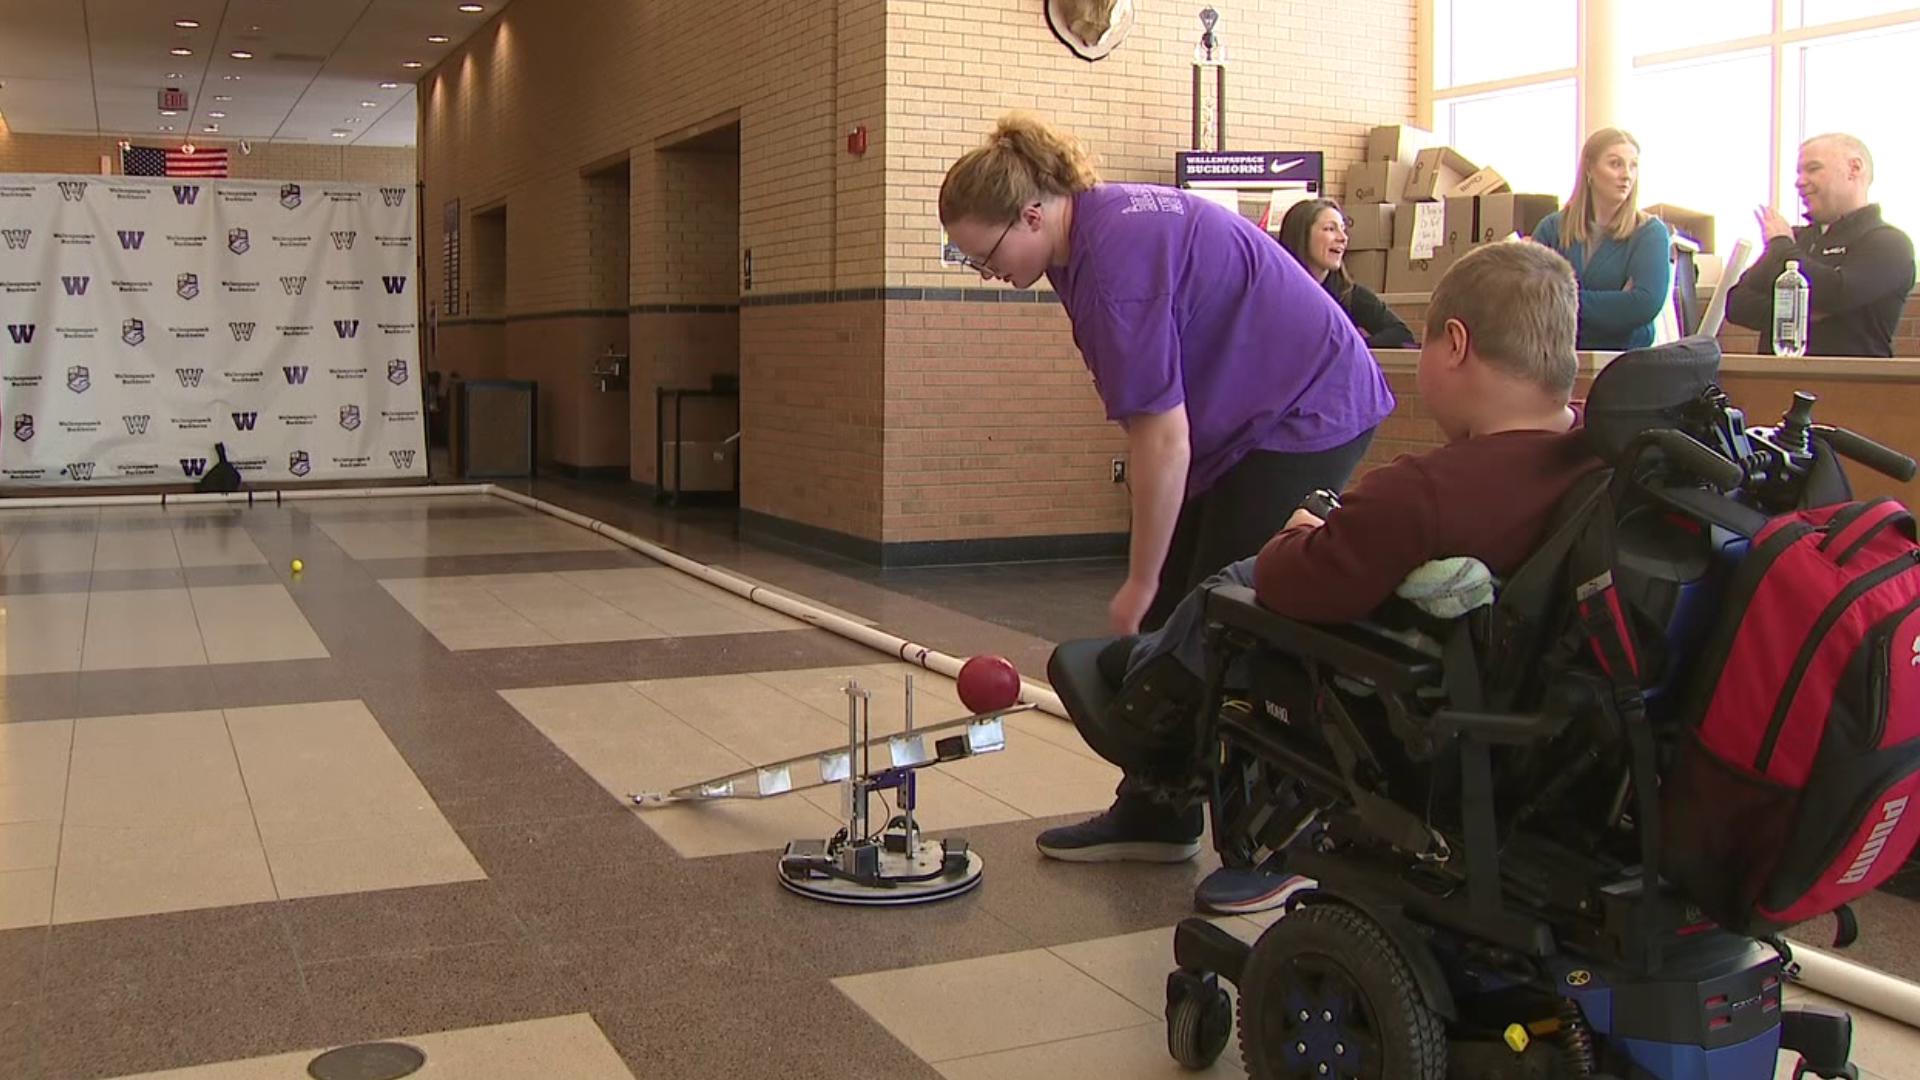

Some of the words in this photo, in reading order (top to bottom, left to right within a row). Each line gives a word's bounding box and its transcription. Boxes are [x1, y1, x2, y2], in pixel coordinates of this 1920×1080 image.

[1186, 165, 1265, 174] BUCKHORNS
[57, 181, 88, 201] W
[172, 185, 199, 205] W
[379, 188, 405, 207] W
[1, 229, 32, 249] W
[117, 231, 144, 249] W
[329, 231, 356, 250] W
[61, 276, 90, 295] W
[280, 276, 307, 295] W
[382, 276, 406, 294] W
[7, 324, 35, 343] W
[228, 322, 256, 341] W
[333, 320, 359, 338] W
[175, 368, 203, 388] W
[282, 366, 309, 384] W
[122, 415, 150, 434] W
[231, 412, 258, 430] W
[180, 458, 207, 476] W
[389, 450, 416, 469] W
[67, 462, 96, 480] W
[1836, 795, 1909, 884] PUMA
